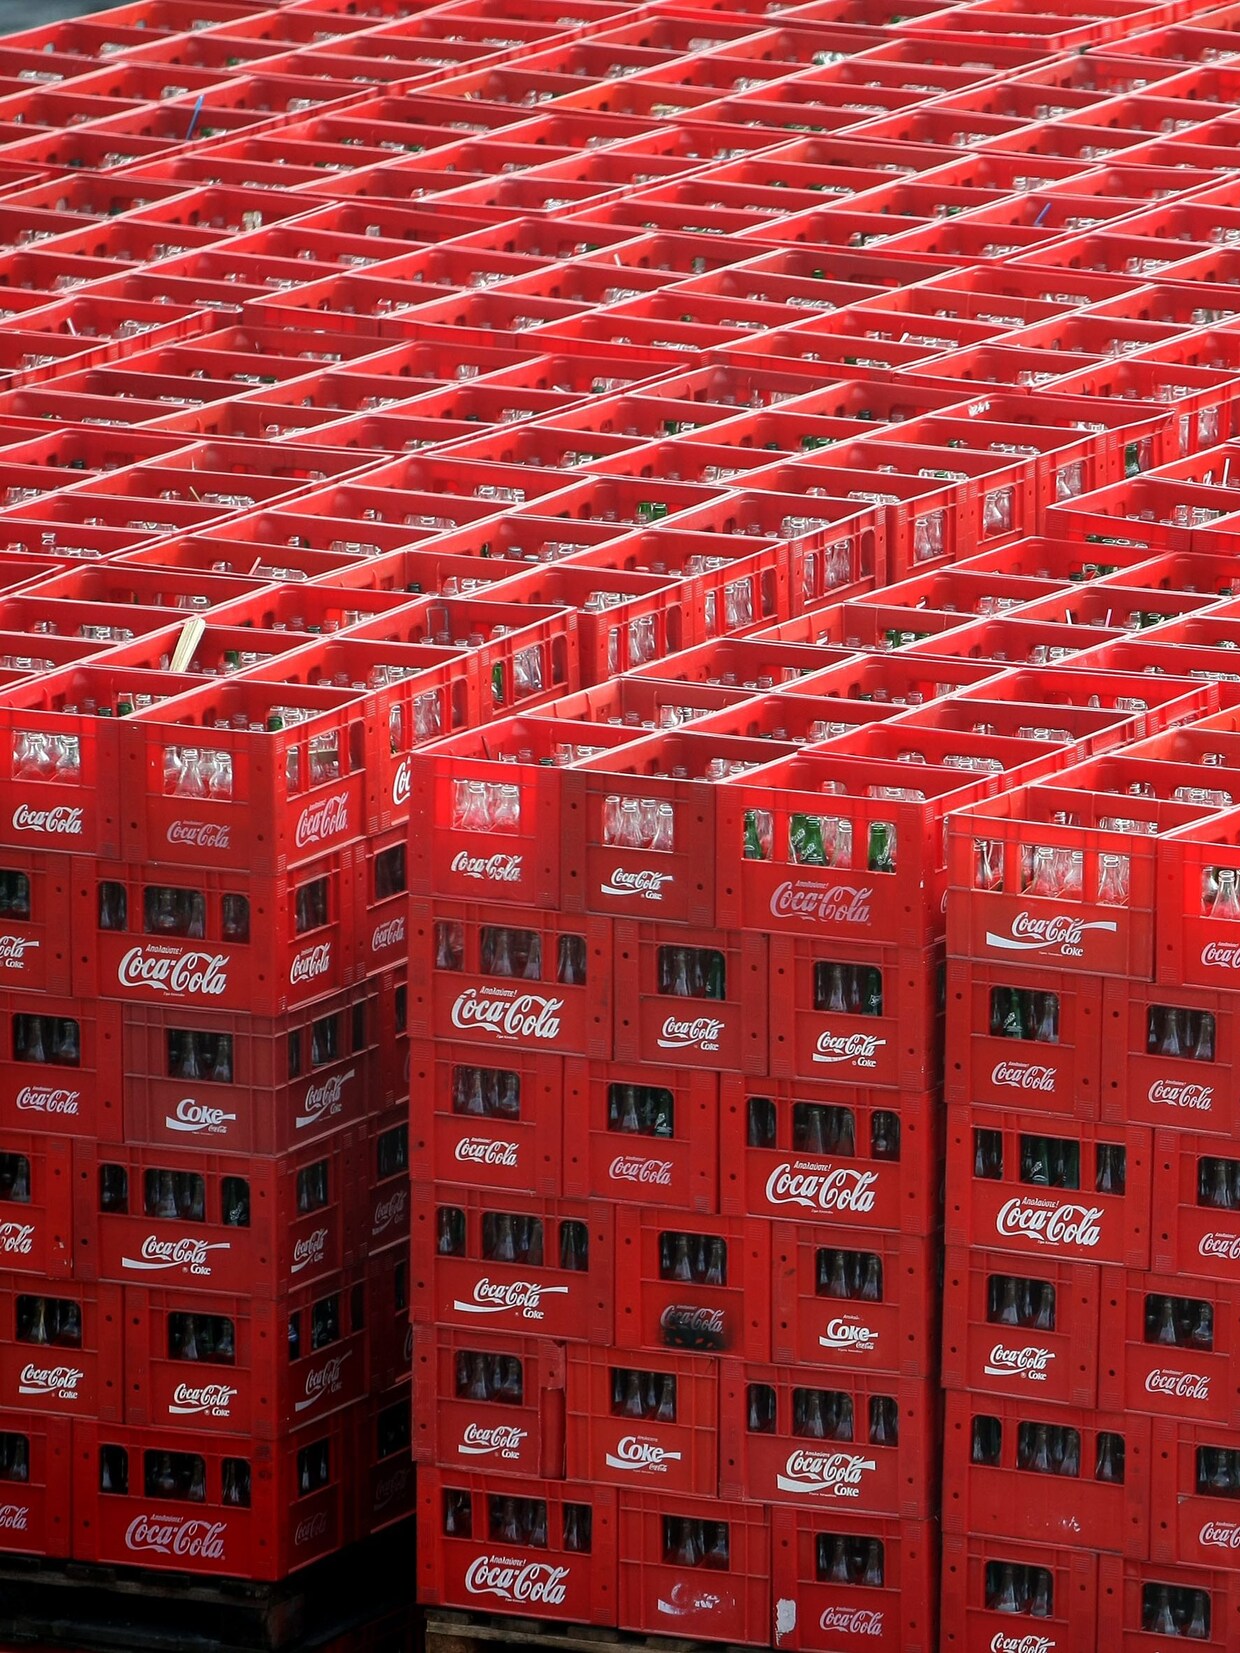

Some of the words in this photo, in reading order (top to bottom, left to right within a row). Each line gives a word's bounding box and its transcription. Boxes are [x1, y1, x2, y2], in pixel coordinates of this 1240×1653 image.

[13, 804, 82, 834] Coca-Cola
[296, 792, 348, 847] Coca-Cola
[167, 821, 231, 848] Coca-Cola
[451, 851, 522, 882] Coca-Cola
[610, 867, 663, 891] Coca-Cola
[770, 881, 873, 924] Coca-Cola
[1012, 911, 1082, 944] Coca-Cola
[118, 947, 231, 995] Coca-Cola
[451, 988, 564, 1039] Coca-Cola
[662, 1016, 720, 1042] Coca-Cola
[817, 1031, 877, 1058] Coca-Cola
[991, 1062, 1056, 1091] Coca-Cola
[17, 1088, 79, 1115] Coca-Cola
[1148, 1080, 1212, 1111] Coca-Cola
[176, 1099, 223, 1124] Coke
[454, 1137, 518, 1167] Coca-Cola
[609, 1157, 672, 1185] Coca-Cola
[766, 1163, 878, 1213] Coca-Cola
[996, 1198, 1104, 1247] Coca-Cola
[142, 1235, 208, 1265] Coca-Cola
[474, 1278, 540, 1308] Coca-Cola
[827, 1318, 869, 1342] Coke
[990, 1344, 1047, 1371] Coca-Cola
[20, 1364, 79, 1388] Coca-Cola
[1145, 1369, 1209, 1400] Coca-Cola
[174, 1383, 231, 1406] Coca-Cola
[463, 1423, 521, 1448] Coca-Cola
[617, 1436, 664, 1463] Coke
[785, 1450, 862, 1483] Coca-Cola
[125, 1514, 227, 1558] Coca-Cola
[465, 1555, 570, 1605] Coca-Cola
[820, 1607, 883, 1636] Coca-Cola
